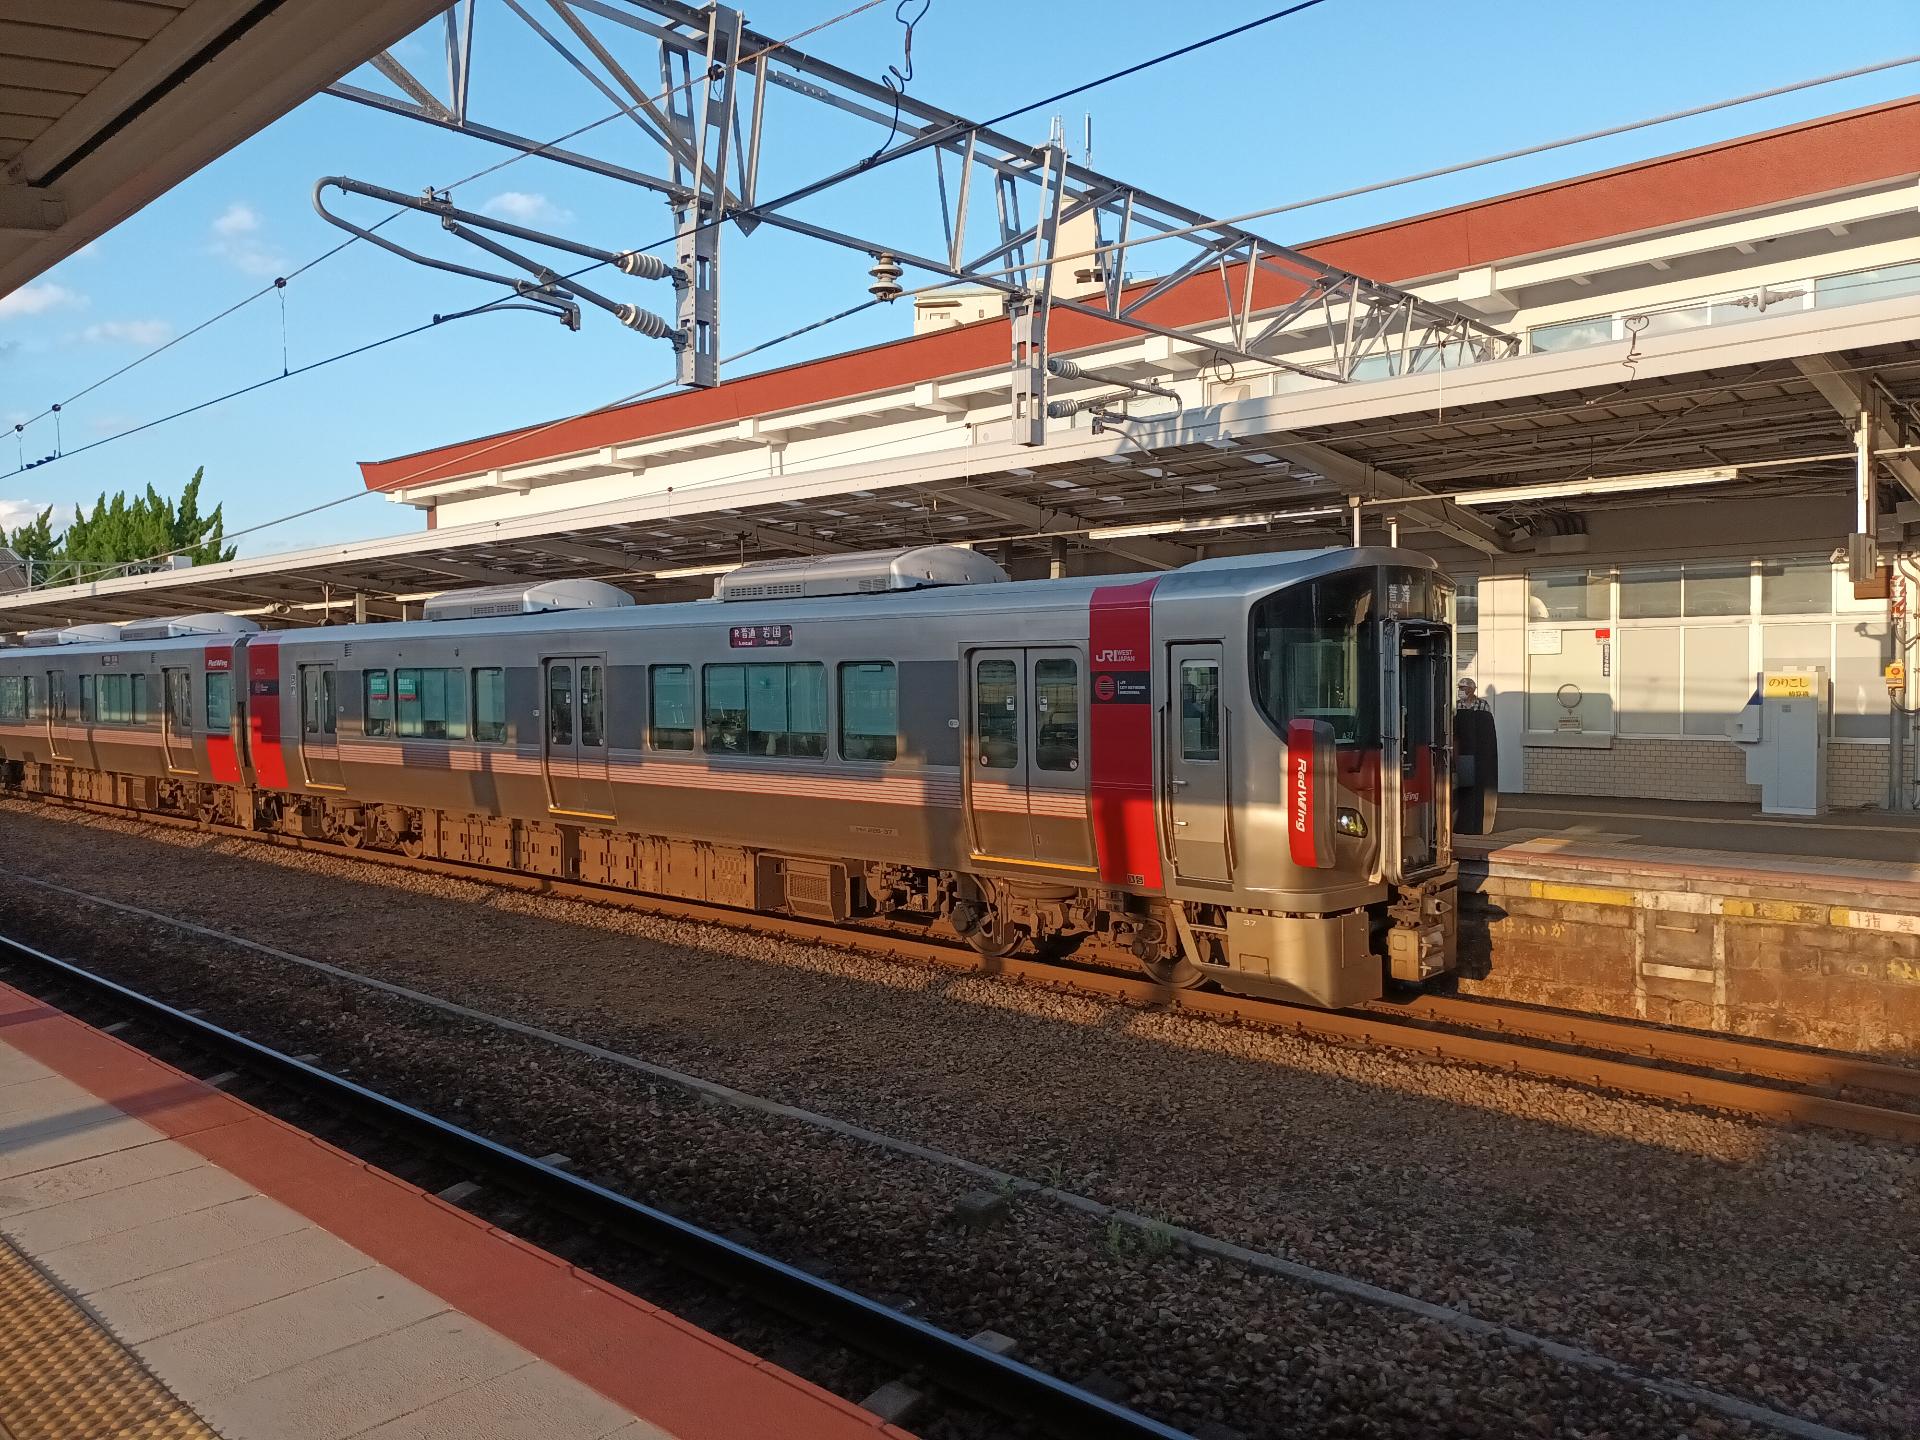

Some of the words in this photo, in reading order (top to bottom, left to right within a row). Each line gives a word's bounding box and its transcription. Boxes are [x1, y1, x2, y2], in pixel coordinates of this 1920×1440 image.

[741, 628, 756, 639] 普通
[763, 626, 781, 638] 岩国
[1096, 649, 1113, 662] JR
[1768, 678, 1808, 688] のりこし
[1296, 758, 1307, 832] RedWing
[1243, 919, 1257, 927] 37
